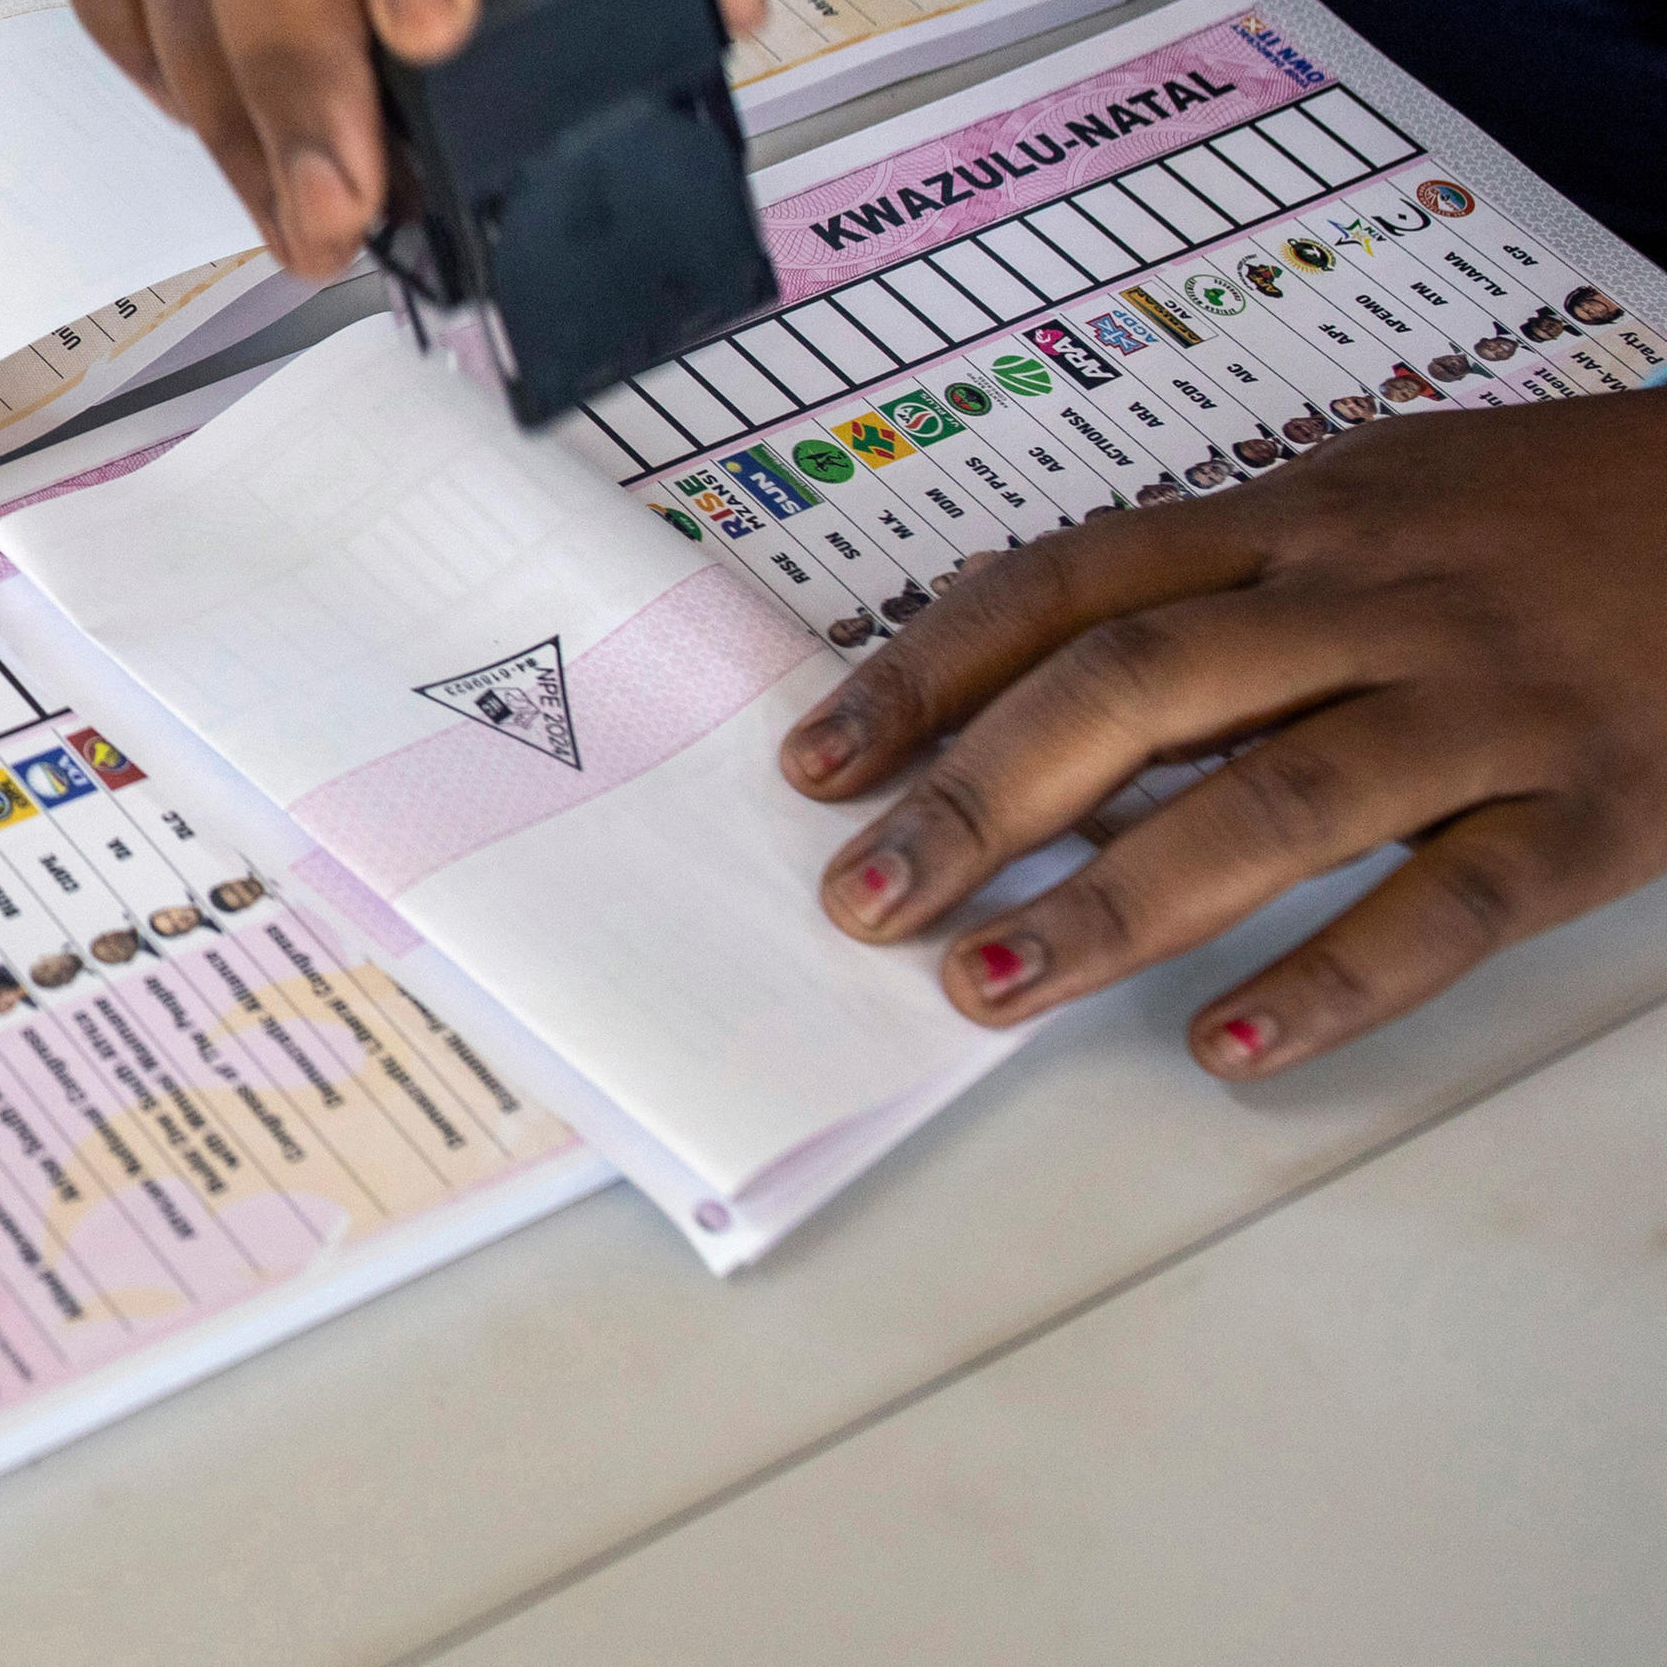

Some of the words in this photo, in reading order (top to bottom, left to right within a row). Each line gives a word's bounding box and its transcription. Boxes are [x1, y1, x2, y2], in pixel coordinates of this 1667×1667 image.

[1276, 47, 1325, 83] OWN
[810, 69, 1237, 252] KWAZULU-NATAL
[1503, 245, 1539, 265] ACP
[1444, 251, 1508, 297] ALJAMA
[1164, 300, 1193, 320] AIC
[1410, 282, 1449, 306] ATM
[1112, 309, 1159, 343] ACDP
[1355, 294, 1412, 334] APEMO
[1318, 323, 1356, 345] APF
[1619, 332, 1664, 365] Party
[1052, 338, 1115, 378] ARA
[1227, 363, 1259, 383] AIC
[1172, 379, 1218, 410] ACDP
[1128, 401, 1165, 429] ARA
[1060, 407, 1134, 467] ACTIONSA
[965, 456, 1008, 490] PLUS
[1028, 446, 1065, 473] ABC
[673, 473, 754, 540] RISE
[696, 470, 766, 531] MZANSI
[749, 471, 802, 517] SUN
[925, 488, 965, 519] UDM
[999, 490, 1028, 509] VF
[878, 509, 916, 540] M.K.
[825, 531, 861, 561] SUN
[770, 552, 811, 584] RISE
[534, 666, 563, 708] NPE
[58, 753, 91, 788] DA
